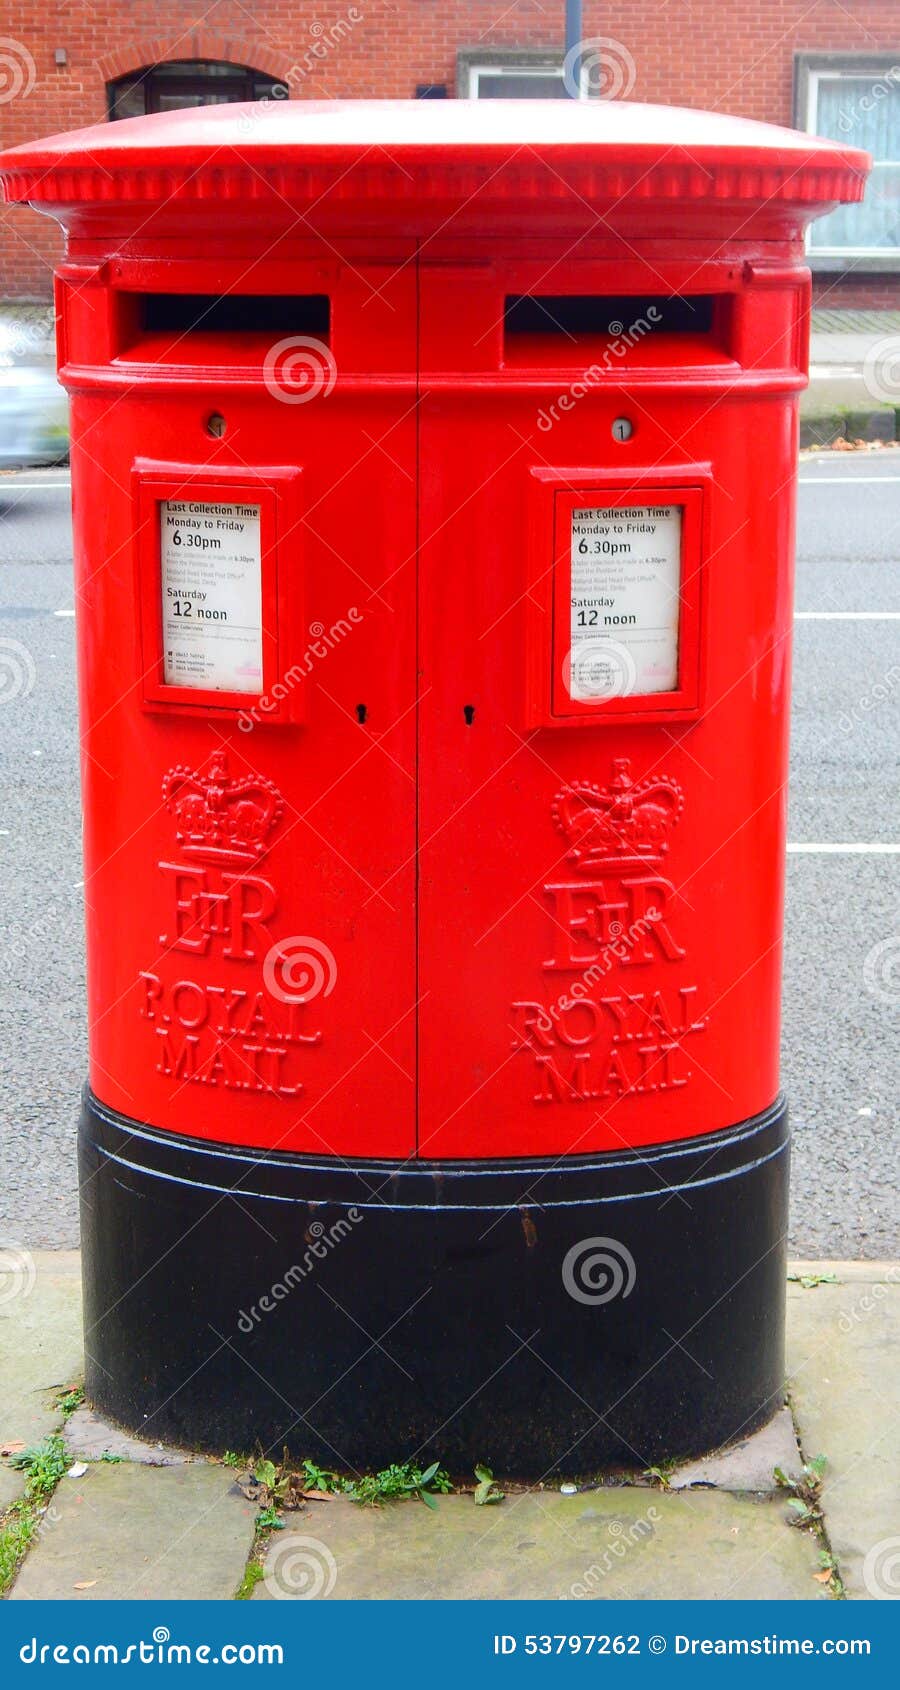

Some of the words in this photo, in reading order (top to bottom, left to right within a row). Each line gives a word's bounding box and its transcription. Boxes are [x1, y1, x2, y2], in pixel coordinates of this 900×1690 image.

[166, 502, 186, 512] Last
[189, 503, 233, 515] Collection
[236, 506, 258, 517] Time
[572, 509, 593, 520] Last
[597, 508, 643, 519] Collection
[647, 507, 670, 518] Time
[166, 517, 201, 529] Monday
[205, 520, 213, 529] to
[216, 520, 244, 532] Friday
[572, 525, 610, 536] Monday
[614, 525, 623, 533] to
[627, 523, 656, 534] Friday
[173, 530, 221, 550] 6.30pm
[578, 538, 631, 556] 6.30pm
[167, 587, 207, 600] Saturday
[571, 597, 615, 607] Saturday
[173, 601, 192, 617] 12
[197, 609, 227, 620] noon
[577, 610, 598, 626] 12
[604, 615, 636, 625] noon
[139, 971, 322, 1044] ROYAL
[511, 985, 709, 1049] ROYAL
[155, 1026, 304, 1095] MAIL
[533, 1042, 691, 1102] MAIL
